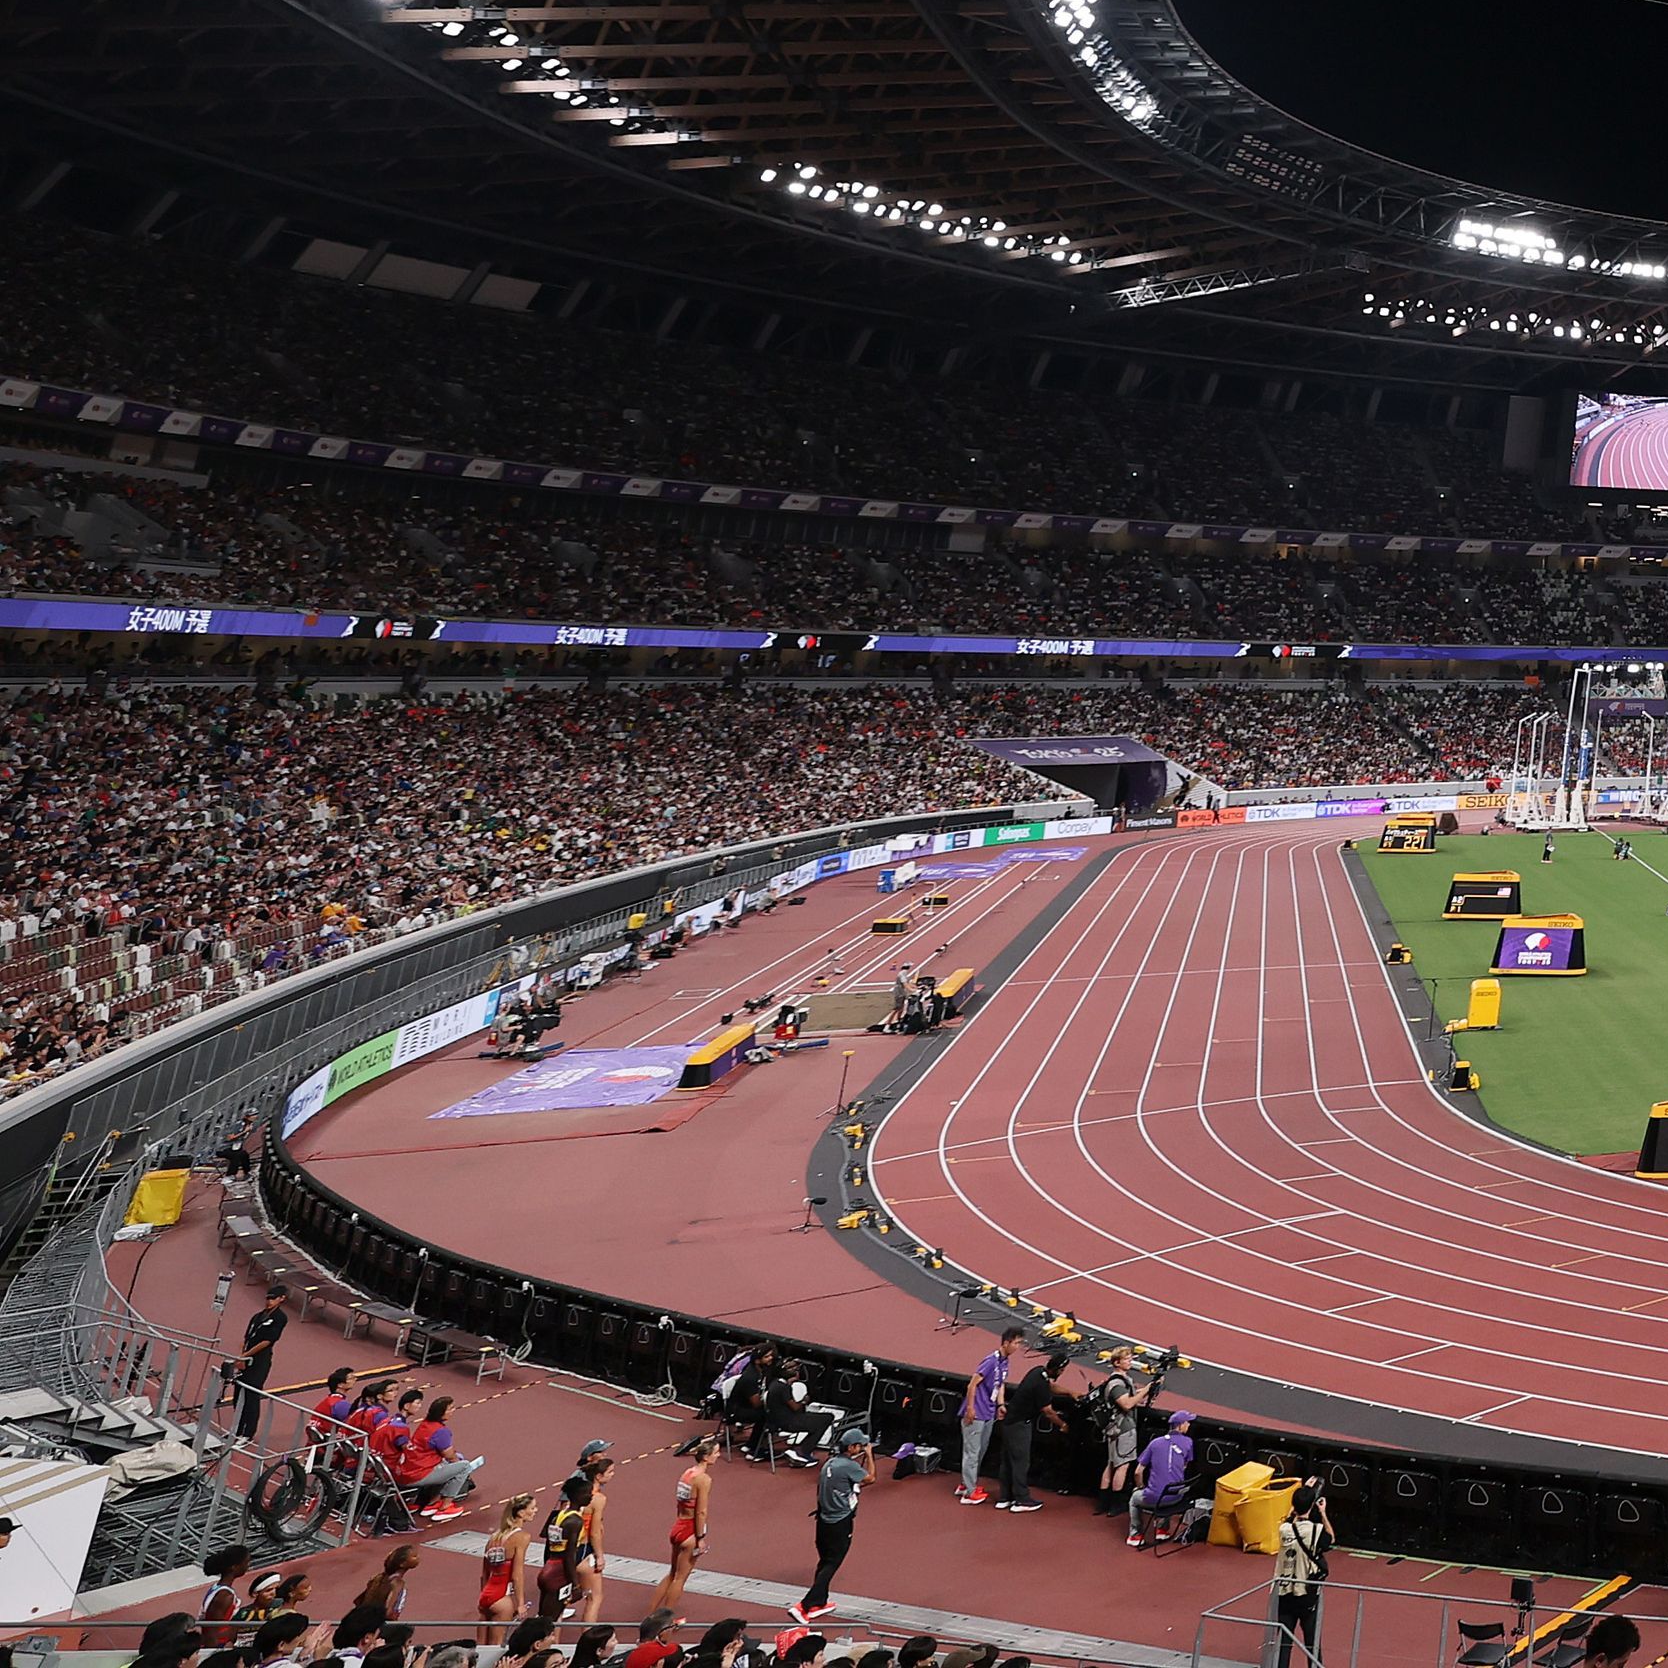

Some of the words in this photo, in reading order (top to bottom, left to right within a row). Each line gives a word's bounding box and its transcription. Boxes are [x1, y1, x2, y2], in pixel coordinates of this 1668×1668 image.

[126, 606, 185, 633] 女子400M
[1016, 639, 1069, 655] 女子400M
[1093, 746, 1126, 758] 25
[1396, 799, 1420, 811] TDK
[1466, 794, 1516, 809] SEIKO
[1257, 808, 1280, 819] TDK
[1327, 803, 1351, 815] TDK
[1192, 812, 1212, 822] WORLD
[1058, 820, 1092, 835] Corpay
[1404, 835, 1425, 850] 221
[337, 1058, 359, 1085] WORLD
[358, 1042, 394, 1070] ATHLETICS
[562, 1585, 571, 1597] 4
